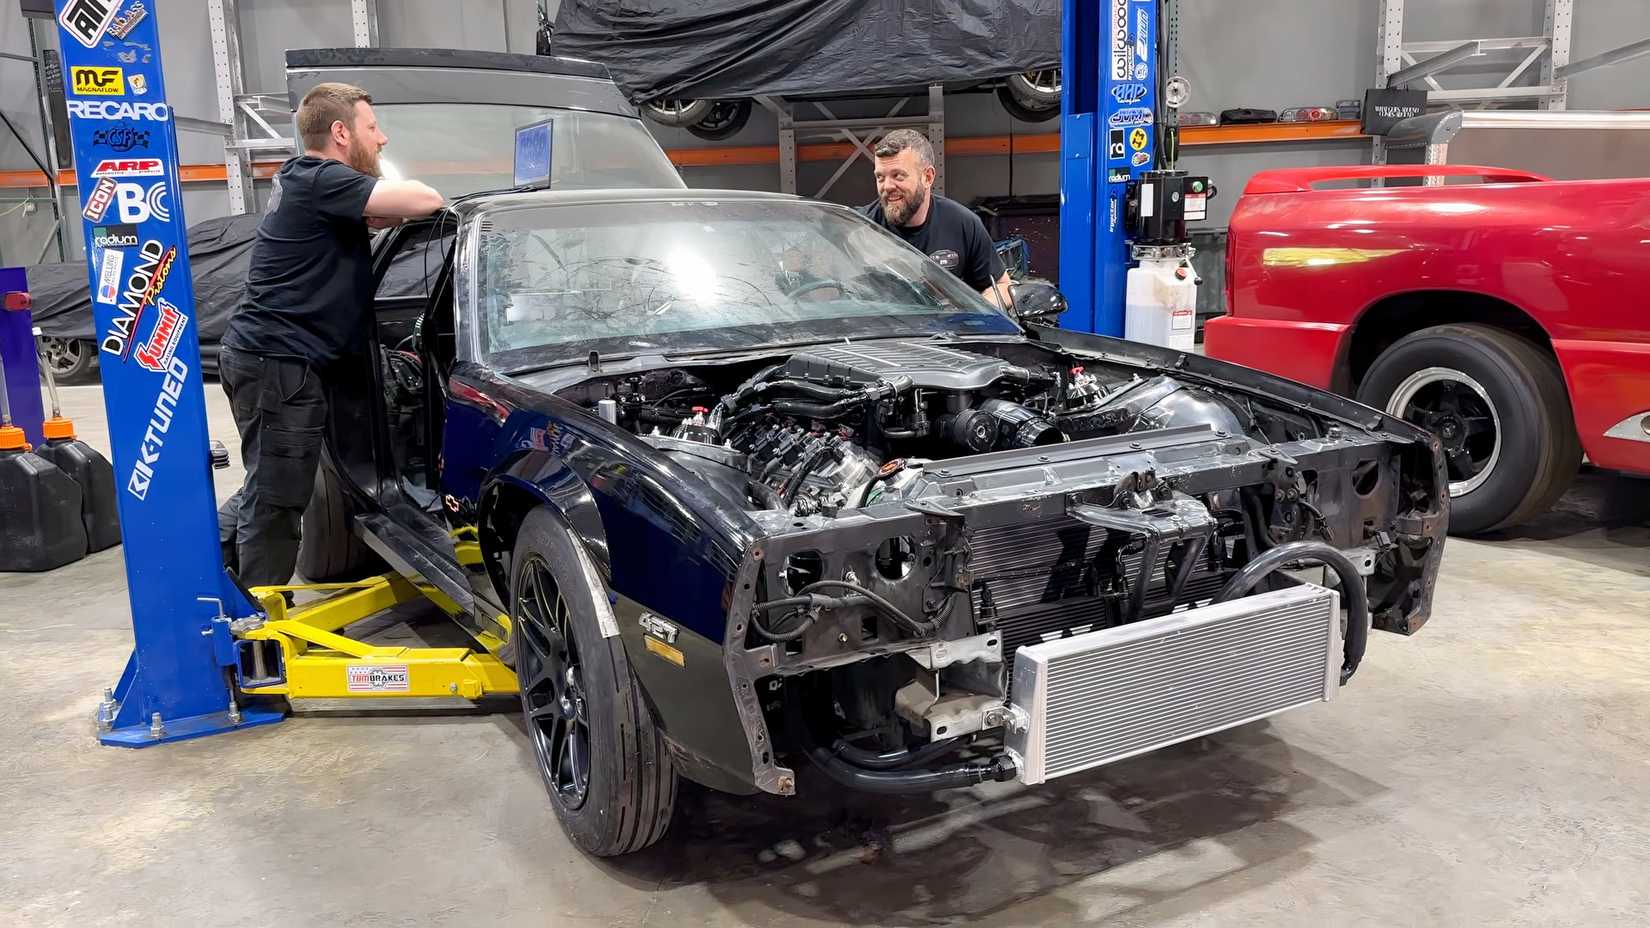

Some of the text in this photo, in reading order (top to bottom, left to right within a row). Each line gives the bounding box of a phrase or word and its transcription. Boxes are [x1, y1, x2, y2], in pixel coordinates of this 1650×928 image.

[76, 70, 119, 87] MF
[67, 101, 168, 121] RECARO
[97, 161, 160, 171] ARP
[86, 179, 115, 220] ICON
[144, 247, 177, 306] Pistons
[101, 239, 164, 356] DIAMOND
[639, 611, 678, 643] 427
